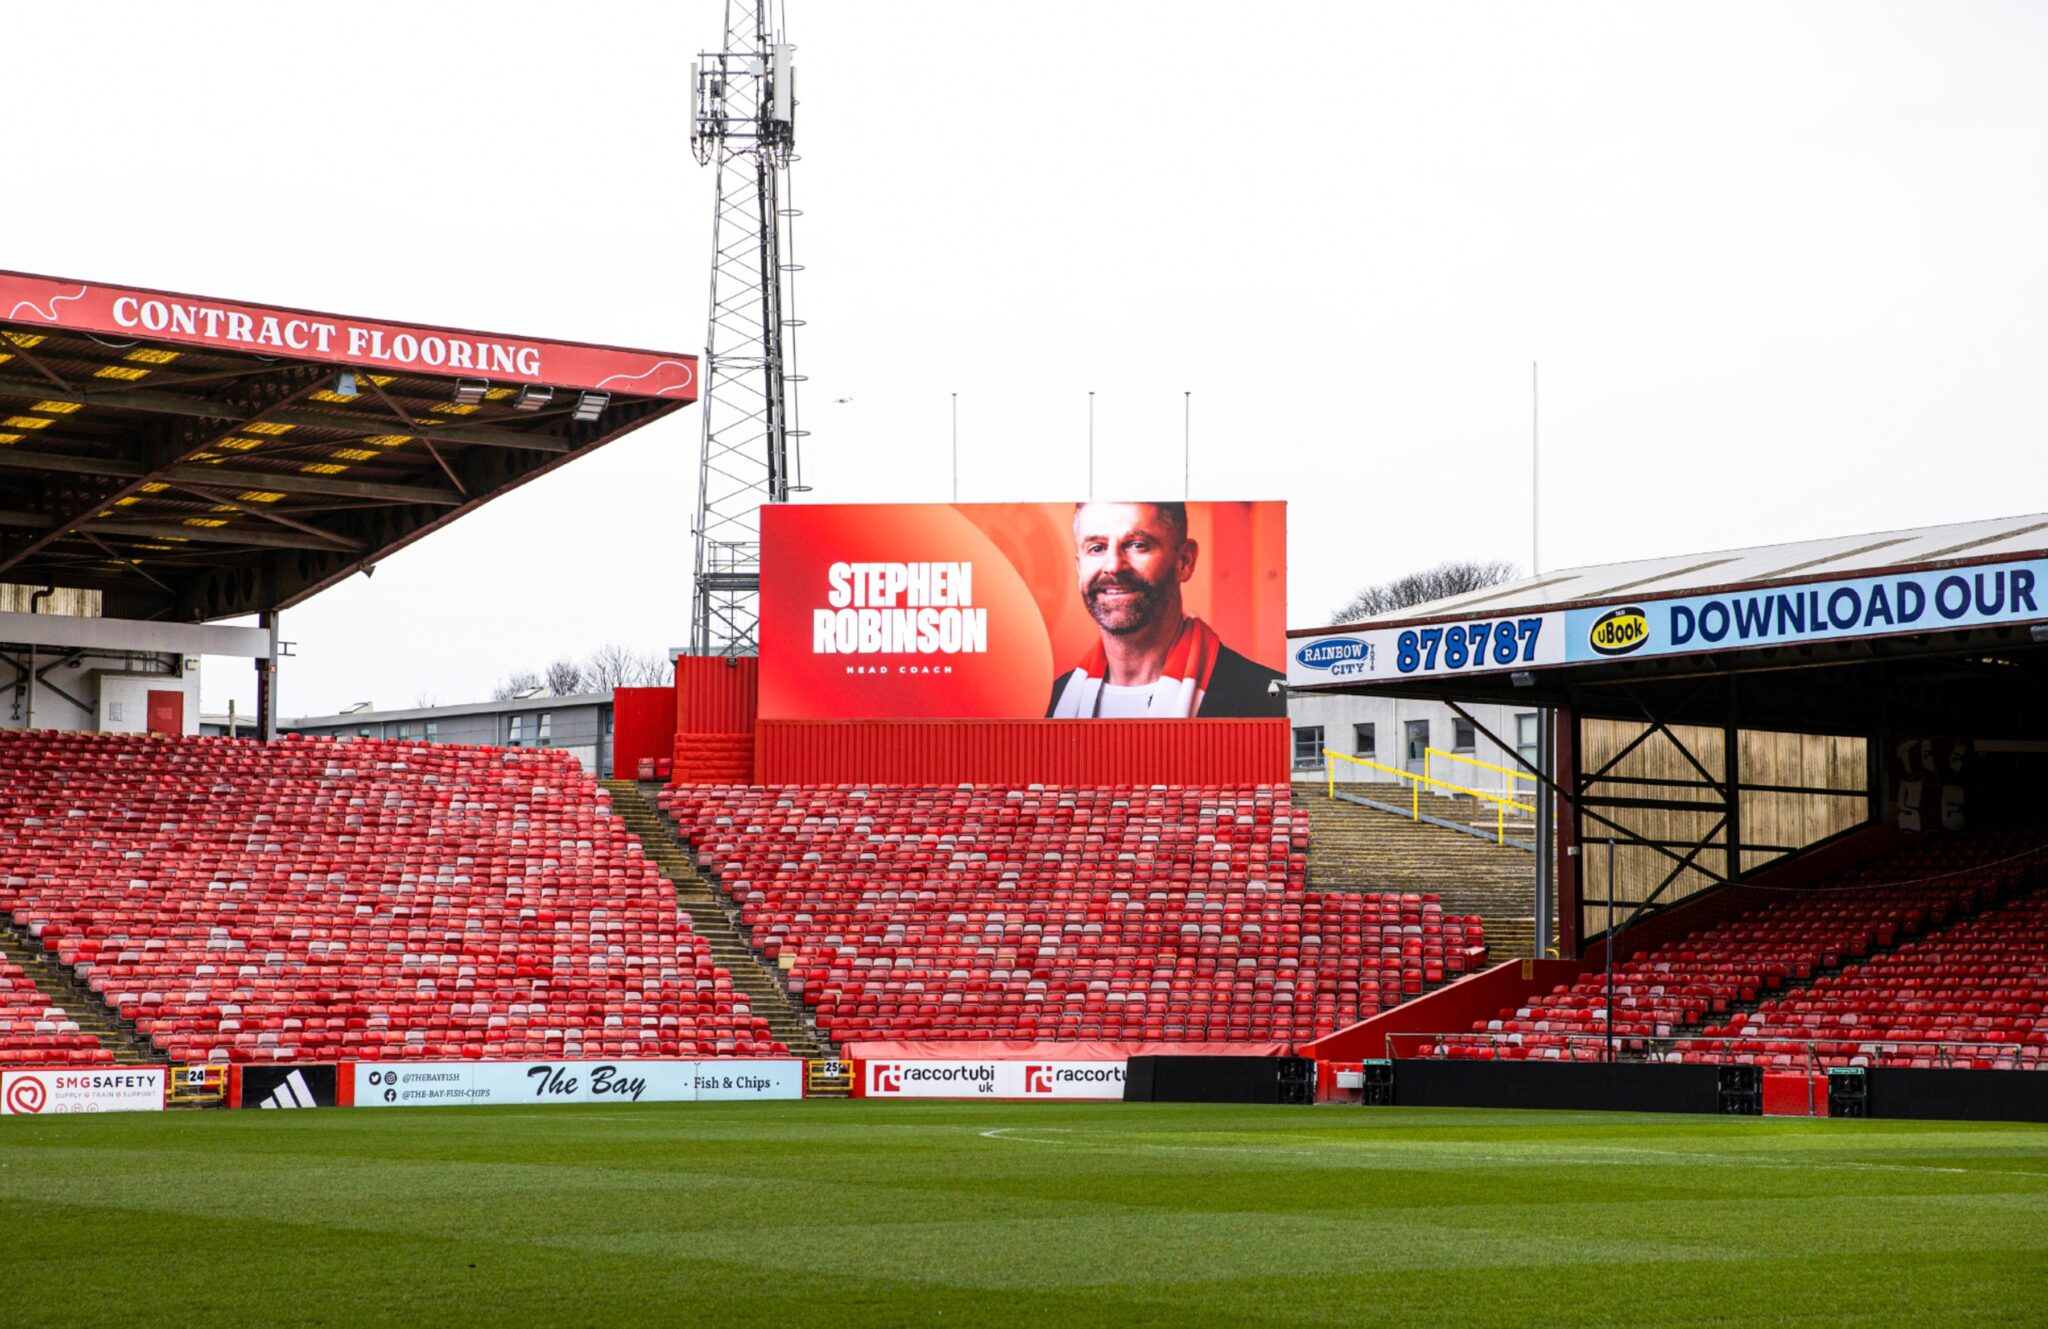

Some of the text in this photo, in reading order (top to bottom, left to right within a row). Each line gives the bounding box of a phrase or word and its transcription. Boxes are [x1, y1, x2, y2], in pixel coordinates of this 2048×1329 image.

[112, 297, 541, 376] CONTRACT FLOORING
[828, 561, 972, 608] STEPHEN
[1670, 569, 2038, 646] DOWNLOAD OUR
[813, 608, 987, 654] ROBINSON
[1598, 617, 1643, 644] uBook
[1304, 644, 1363, 662] RAINBOW
[1397, 617, 1543, 673] 878787
[846, 666, 952, 674] HEAD COACH
[1331, 663, 1364, 675] CITY
[826, 1062, 837, 1072] 25
[904, 1065, 994, 1081] raccortubi
[56, 1076, 156, 1089] SMGSAFETY
[190, 1070, 204, 1081] 24
[402, 1073, 460, 1083] @THEBAYFISH
[527, 1065, 646, 1101] The Bay
[694, 1076, 771, 1092] Fish & Chips
[979, 1082, 993, 1093] uk
